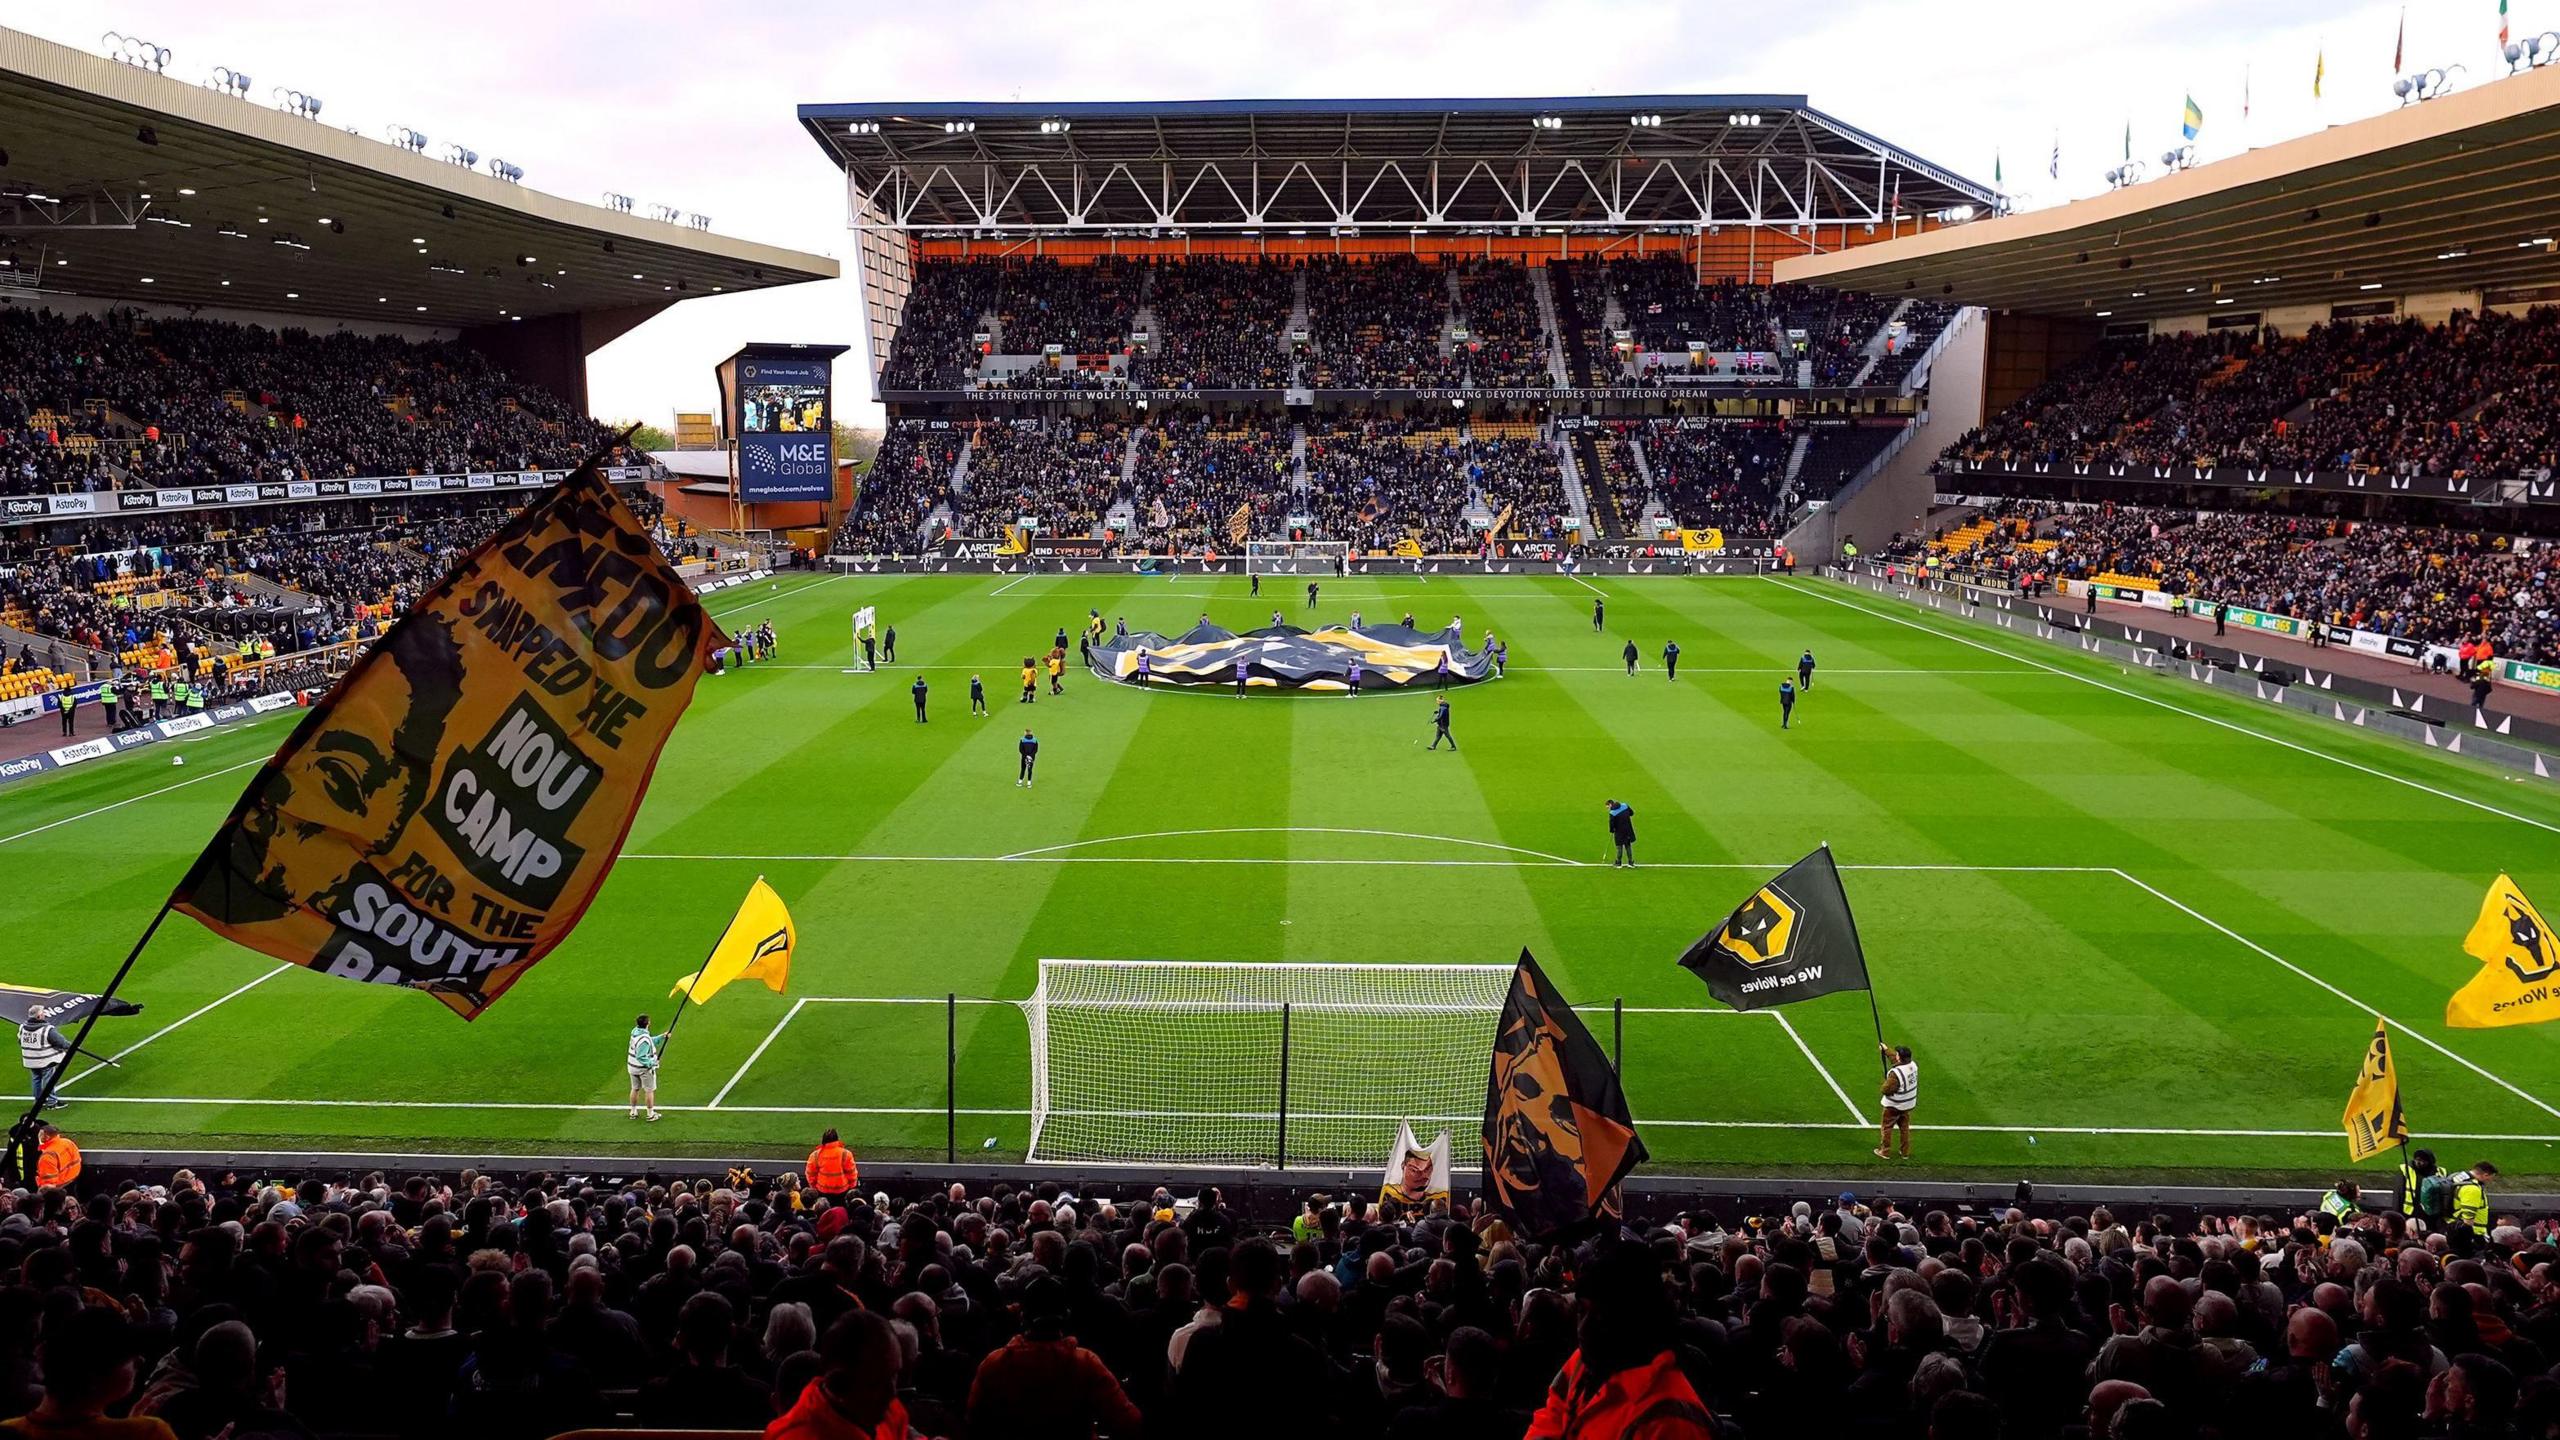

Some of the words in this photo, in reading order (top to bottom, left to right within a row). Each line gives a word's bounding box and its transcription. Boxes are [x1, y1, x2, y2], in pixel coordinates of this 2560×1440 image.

[965, 391, 984, 400] THE
[989, 391, 1041, 400] STRENGTH
[1046, 391, 1058, 400] OF
[1063, 391, 1082, 400] THE
[1086, 391, 1116, 400] WOLF
[1121, 391, 1130, 400] IS
[1135, 391, 1147, 400] IN
[1151, 391, 1170, 400] THE
[1174, 391, 1200, 400] PACK
[1416, 390, 1437, 399] OUR
[1442, 390, 1481, 399] LOVING
[1486, 390, 1540, 399] DEVOTION
[1545, 390, 1585, 399] GUIDES
[1590, 390, 1611, 399] OUR
[1616, 390, 1667, 399] LIFELONG
[1672, 390, 1708, 399] DREAM
[931, 421, 949, 429] END
[780, 444, 825, 461] M&E
[780, 462, 826, 475] Global
[161, 491, 188, 504] AstroPay
[196, 490, 223, 502] AstroPay
[748, 485, 824, 495] mneglobal.com/wolves
[7, 500, 42, 514] AstroPay
[55, 498, 87, 511] AstroPay
[123, 494, 153, 507] AstroPay
[969, 543, 1000, 552] ARCTIC
[1035, 547, 1052, 555] END
[1523, 543, 1556, 553] ARCTIC
[2229, 608, 2256, 626] bet365
[2262, 615, 2291, 633] bet365
[459, 580, 593, 696] SWAPPED
[2515, 664, 2560, 688] bet365
[215, 705, 246, 721] AstroPay
[168, 715, 202, 733] AstroPay
[117, 729, 154, 747] AstroPay
[62, 743, 101, 761] AstroPay
[486, 707, 590, 811] NOU
[0, 758, 43, 778] AstroPay
[445, 768, 562, 887] CAMP
[386, 850, 456, 915] FOR
[470, 892, 546, 939] THE
[337, 882, 520, 974] SOUTH
[43, 1006, 65, 1018] We
[63, 996, 86, 1009] are
